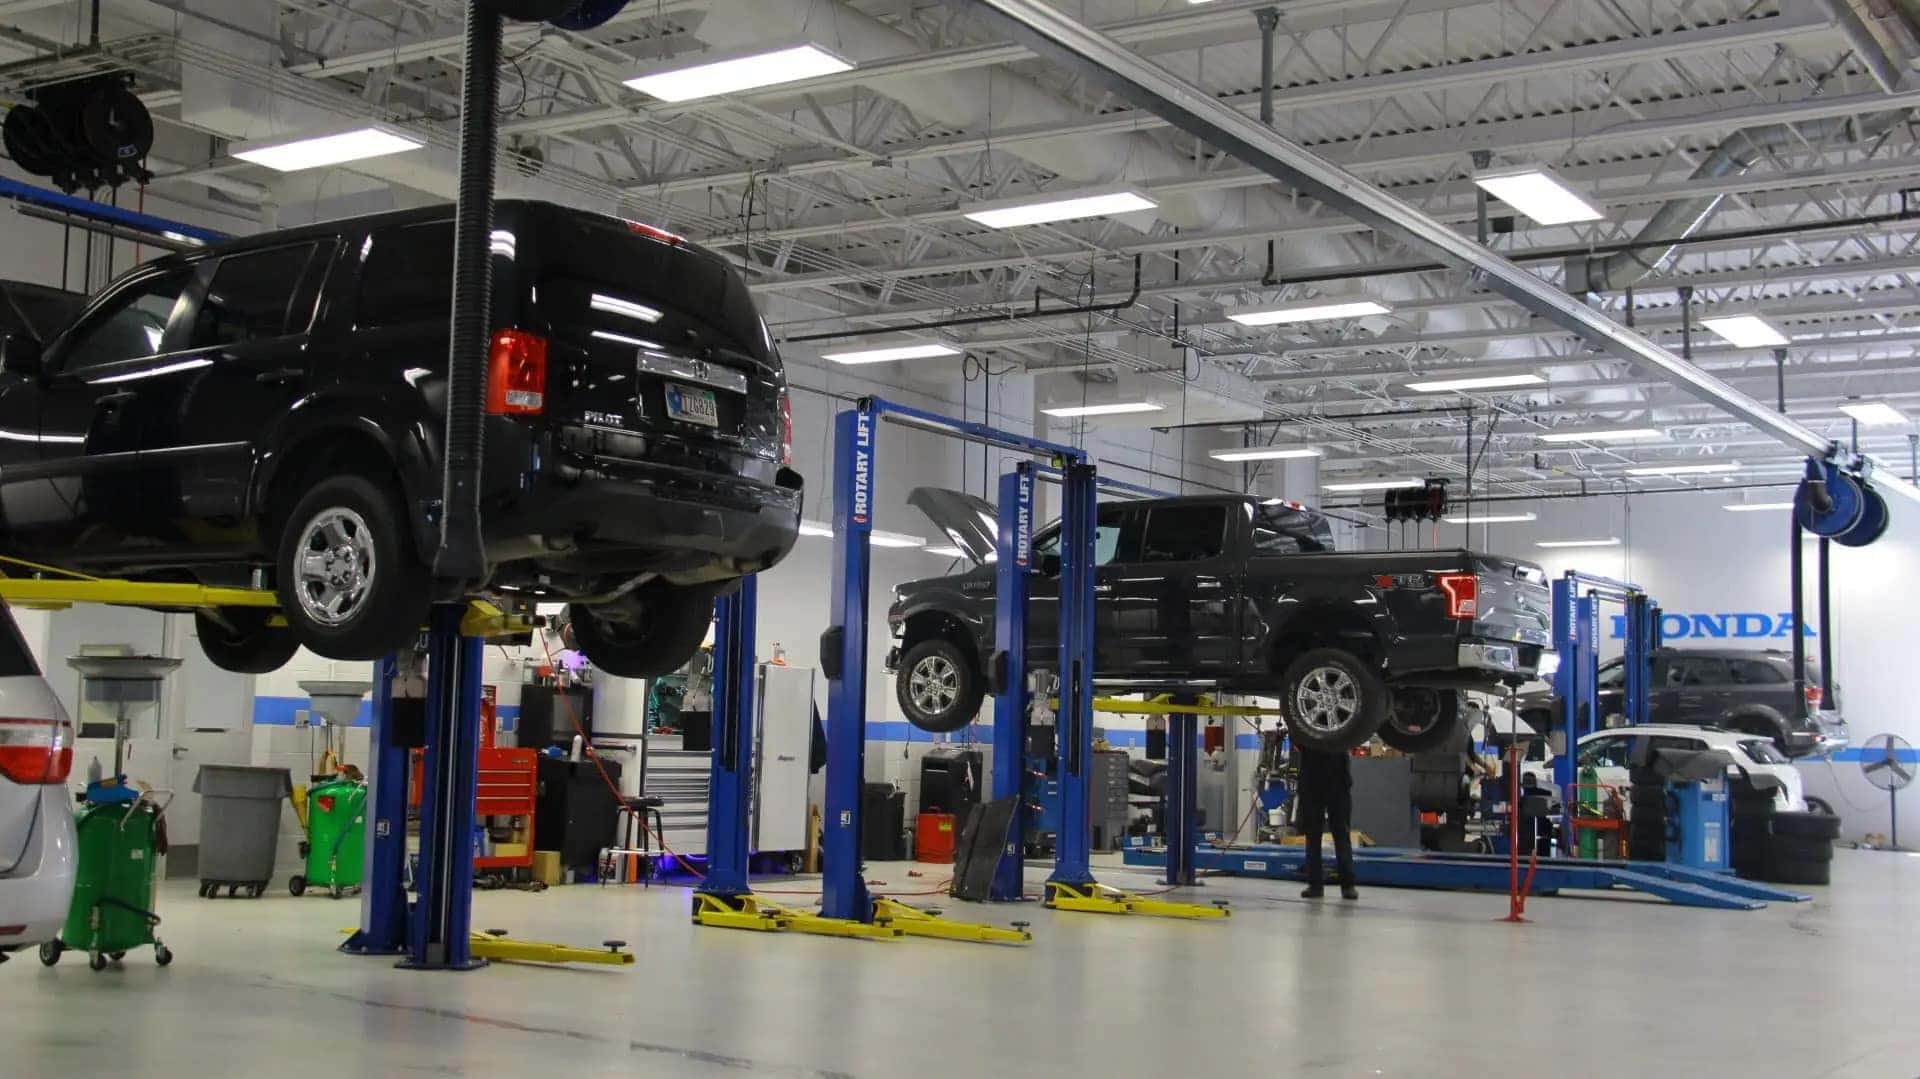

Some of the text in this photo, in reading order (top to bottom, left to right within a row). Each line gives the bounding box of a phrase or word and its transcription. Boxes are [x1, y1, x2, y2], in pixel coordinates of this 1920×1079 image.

[584, 410, 623, 425] PILOT
[855, 412, 870, 514] ROTARY LIFT
[1017, 474, 1030, 559] ROTARY LIFT
